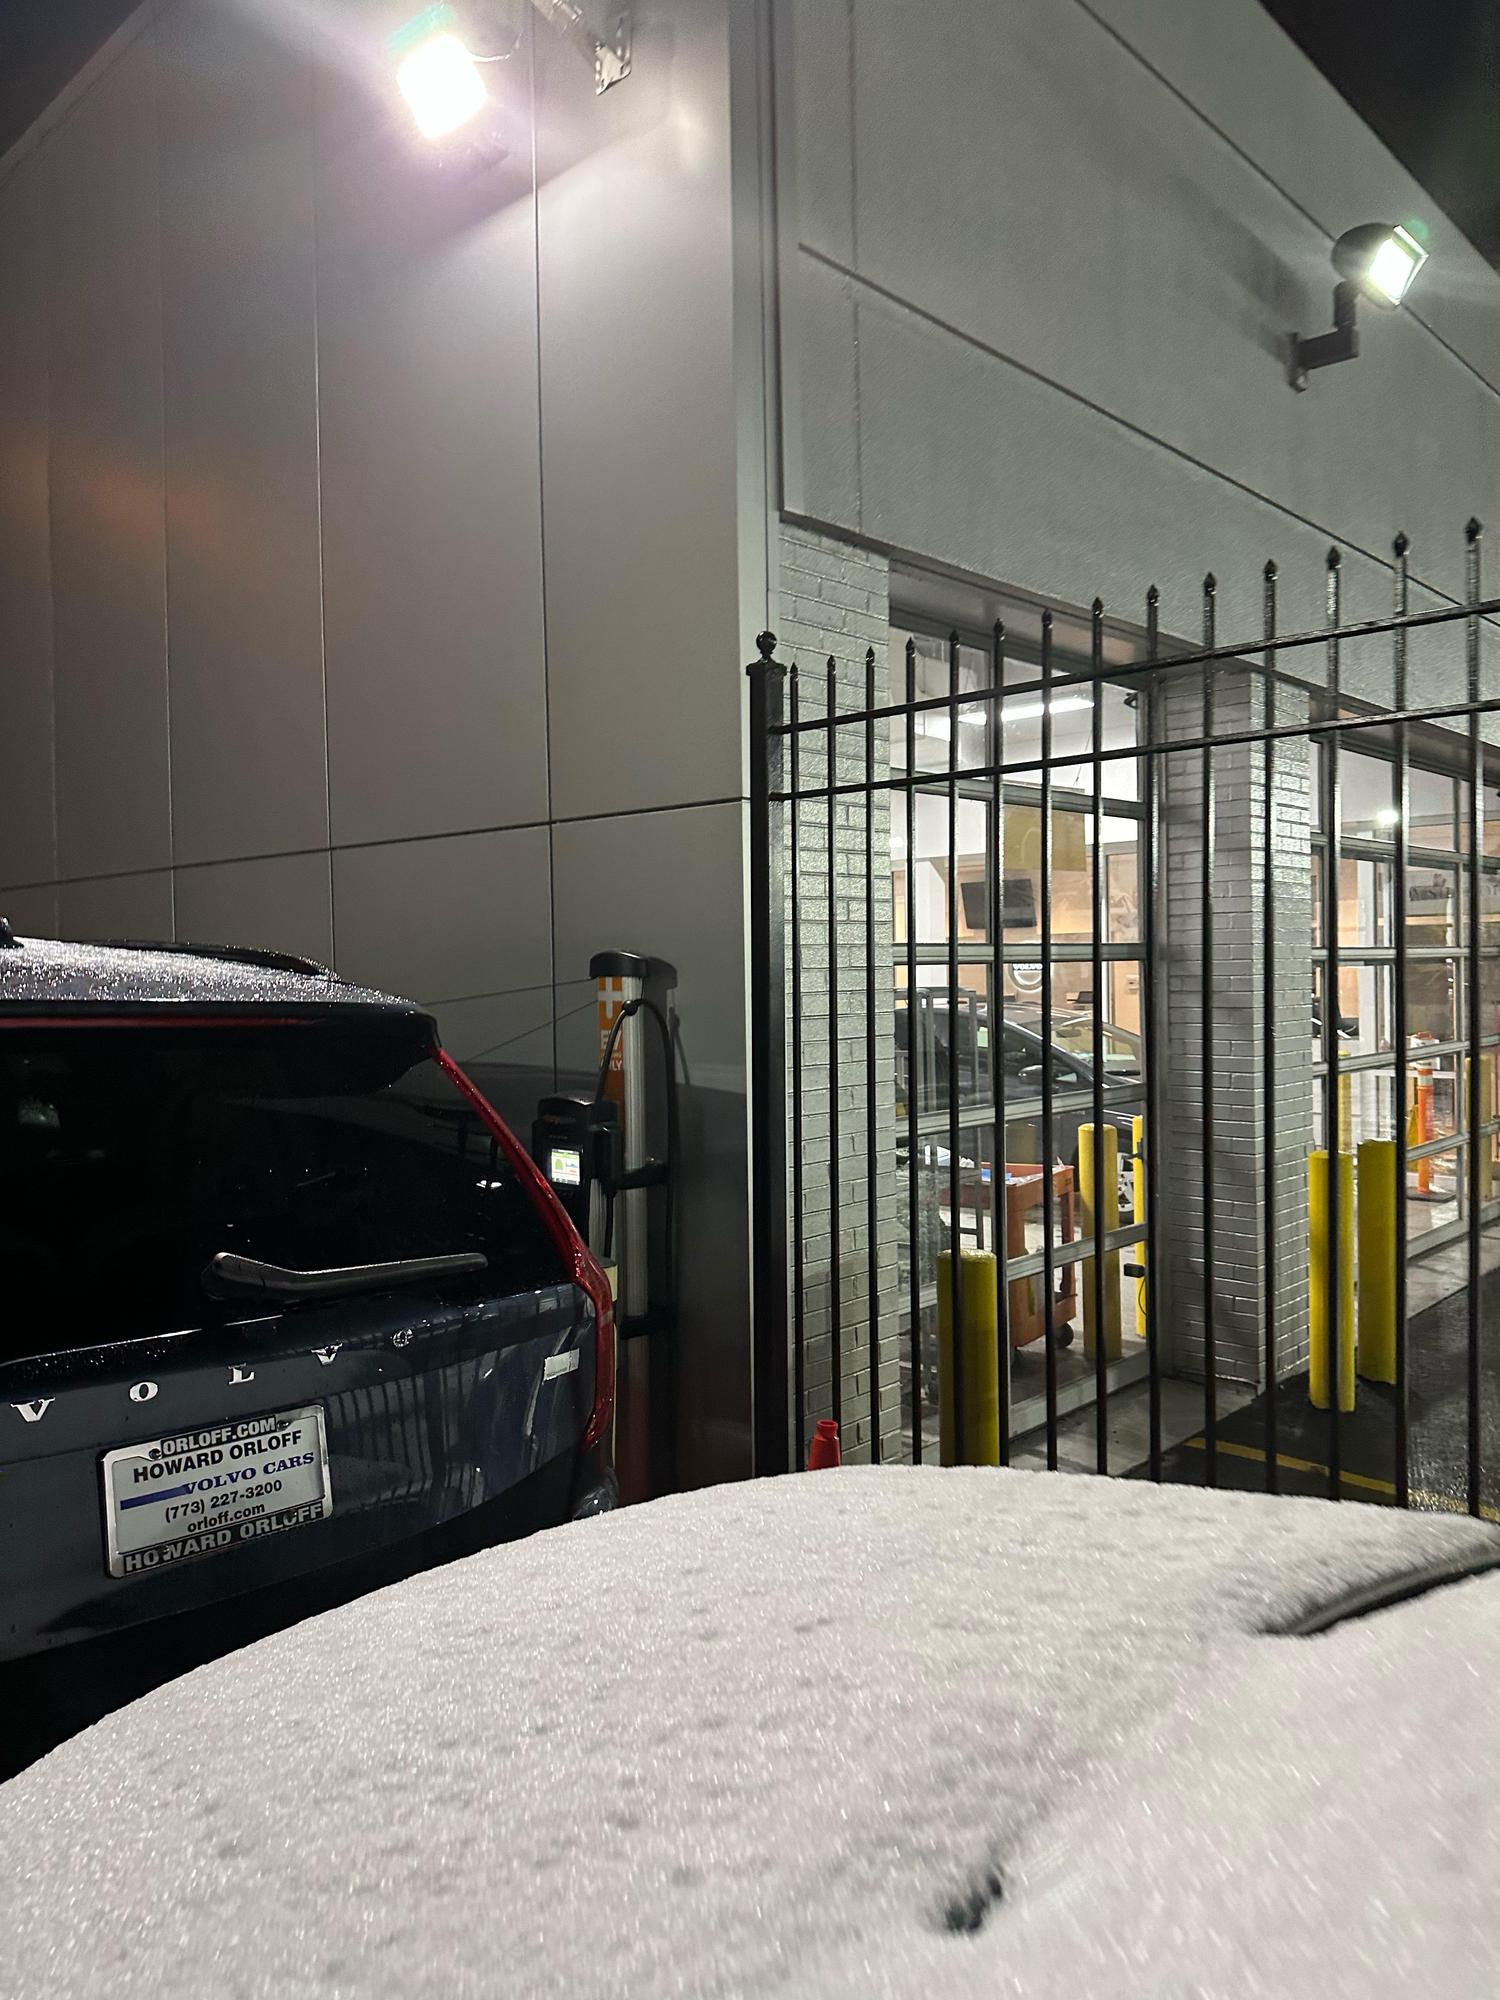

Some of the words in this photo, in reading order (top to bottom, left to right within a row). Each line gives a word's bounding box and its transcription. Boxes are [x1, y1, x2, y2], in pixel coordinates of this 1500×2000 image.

[600, 1059, 622, 1071] LY
[10, 1328, 413, 1423] VOLVO
[133, 1450, 224, 1483] HOWARD
[229, 1430, 302, 1460] ORLOFF
[162, 1416, 276, 1456] ORLOFF.COM
[182, 1466, 257, 1494] VOLVO
[262, 1452, 315, 1475] CARS
[165, 1499, 205, 1523] (773)
[210, 1479, 283, 1510] 227-3200
[187, 1503, 266, 1533] orloff.com
[125, 1529, 232, 1573] HOWARD
